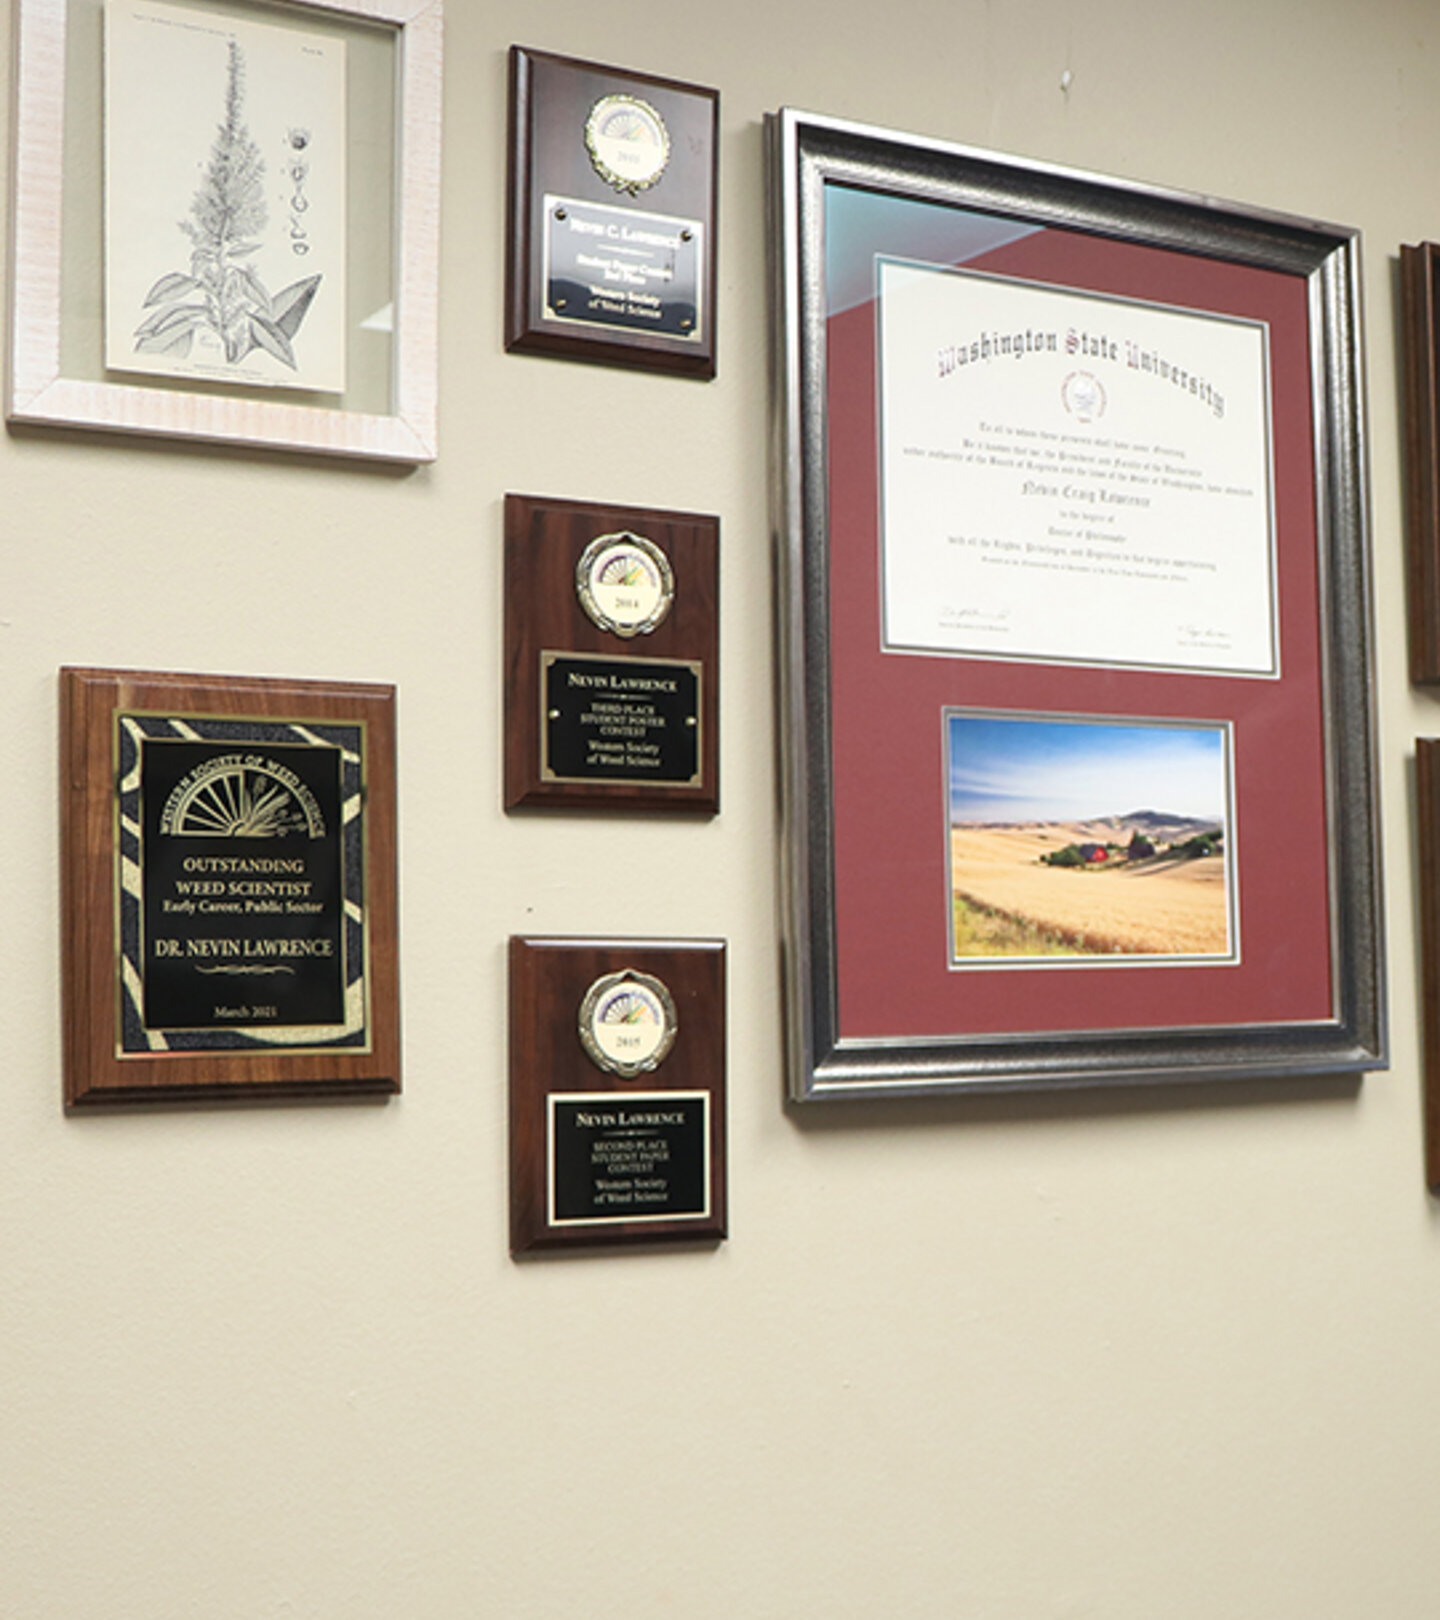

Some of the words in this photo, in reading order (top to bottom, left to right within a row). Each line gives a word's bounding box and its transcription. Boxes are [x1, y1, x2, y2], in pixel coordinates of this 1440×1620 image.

[939, 329, 1056, 378] Washington
[1066, 327, 1117, 361] State
[1125, 340, 1224, 419] University
[588, 740, 624, 751] Western
[627, 741, 659, 755] Society
[160, 777, 192, 835] WESTERN
[191, 755, 243, 780] SOCIETY
[245, 755, 263, 767] OF
[266, 759, 300, 787] WEED
[299, 784, 326, 837] SCIENCE
[183, 857, 304, 874] OUTSTANDING
[176, 881, 225, 895] WEED
[229, 881, 311, 895] SCIENTIST
[163, 901, 195, 915] Early
[200, 901, 243, 914] Career,
[245, 901, 283, 913] Public
[287, 901, 323, 913] Sector
[155, 940, 183, 956] DR.
[187, 940, 242, 956] NEVIN
[244, 940, 333, 956] LAWRENCE
[214, 1006, 249, 1018] March
